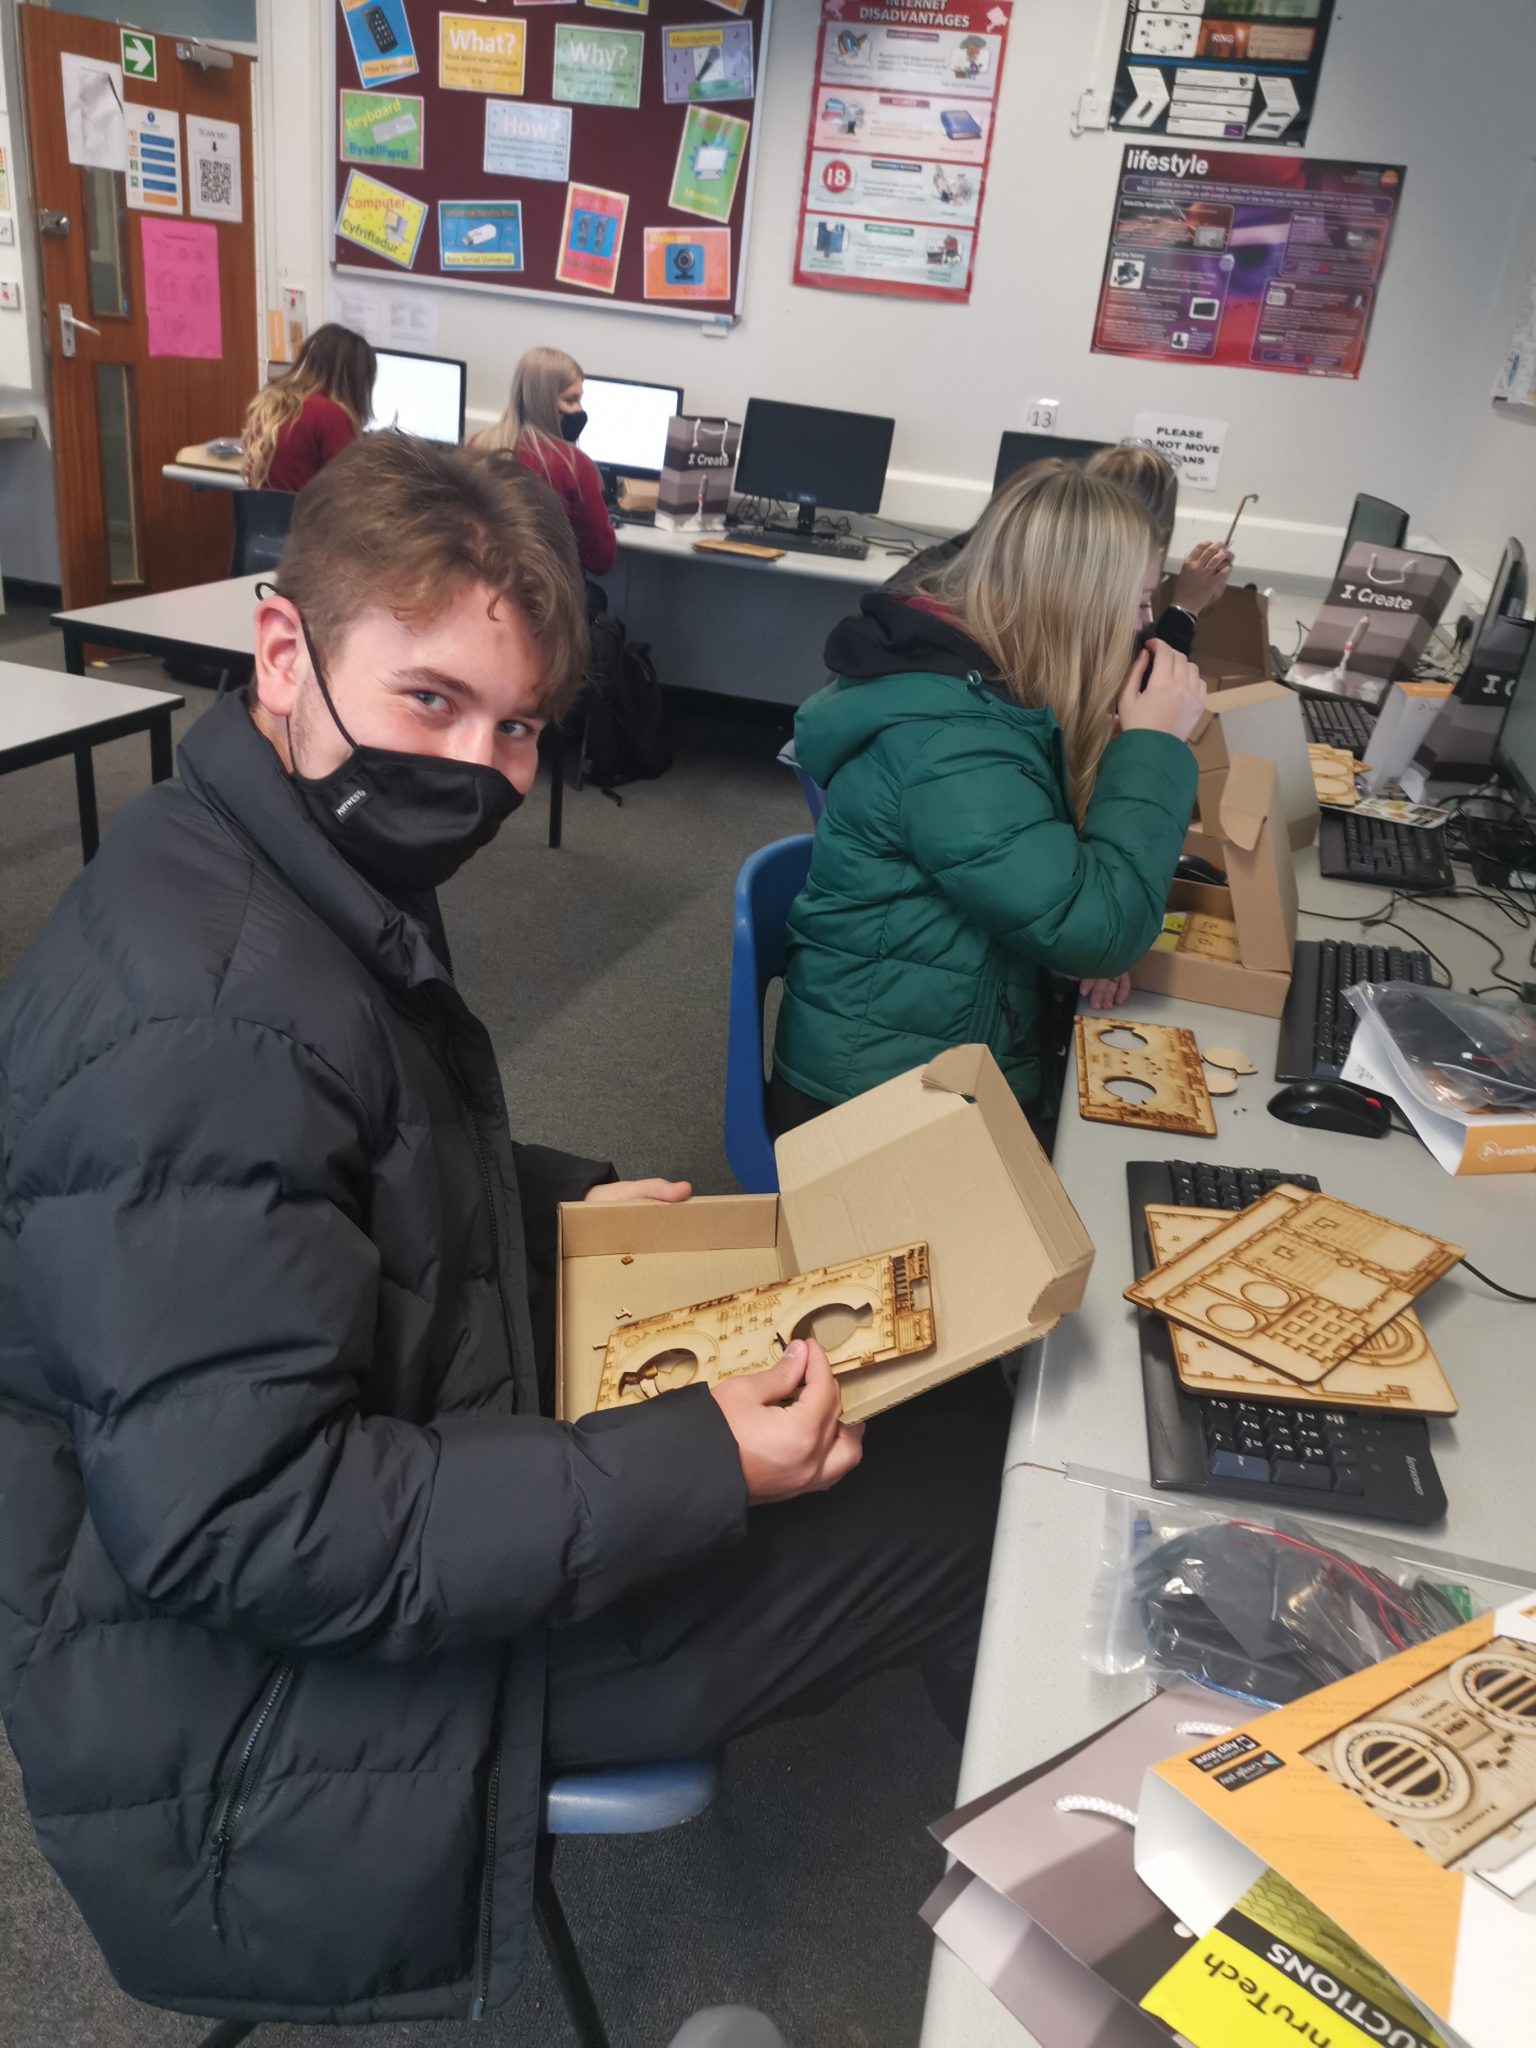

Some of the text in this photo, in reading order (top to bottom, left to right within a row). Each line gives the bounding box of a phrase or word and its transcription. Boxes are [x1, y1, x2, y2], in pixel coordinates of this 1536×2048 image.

[860, 8, 970, 28] DISADVANTAGES
[449, 29, 516, 55] What?
[1211, 33, 1234, 44] RING
[570, 41, 628, 71] Why?
[345, 99, 401, 129] Keyboard
[503, 115, 561, 139] How?
[1126, 150, 1208, 177] lifestyle
[828, 168, 847, 185] 18
[346, 196, 406, 210] Computer
[342, 218, 400, 254] Cyfrifiadur
[1031, 411, 1052, 428] 13
[1156, 427, 1204, 439] PLEASE
[1156, 440, 1182, 450] NOT
[1185, 443, 1220, 454] MOVE
[688, 453, 729, 467] I Create
[1340, 584, 1413, 611] I Create
[1481, 674, 1501, 695] I
[1405, 1455, 1424, 1496] lenovo
[1266, 1943, 1430, 2048] UCTIONS
